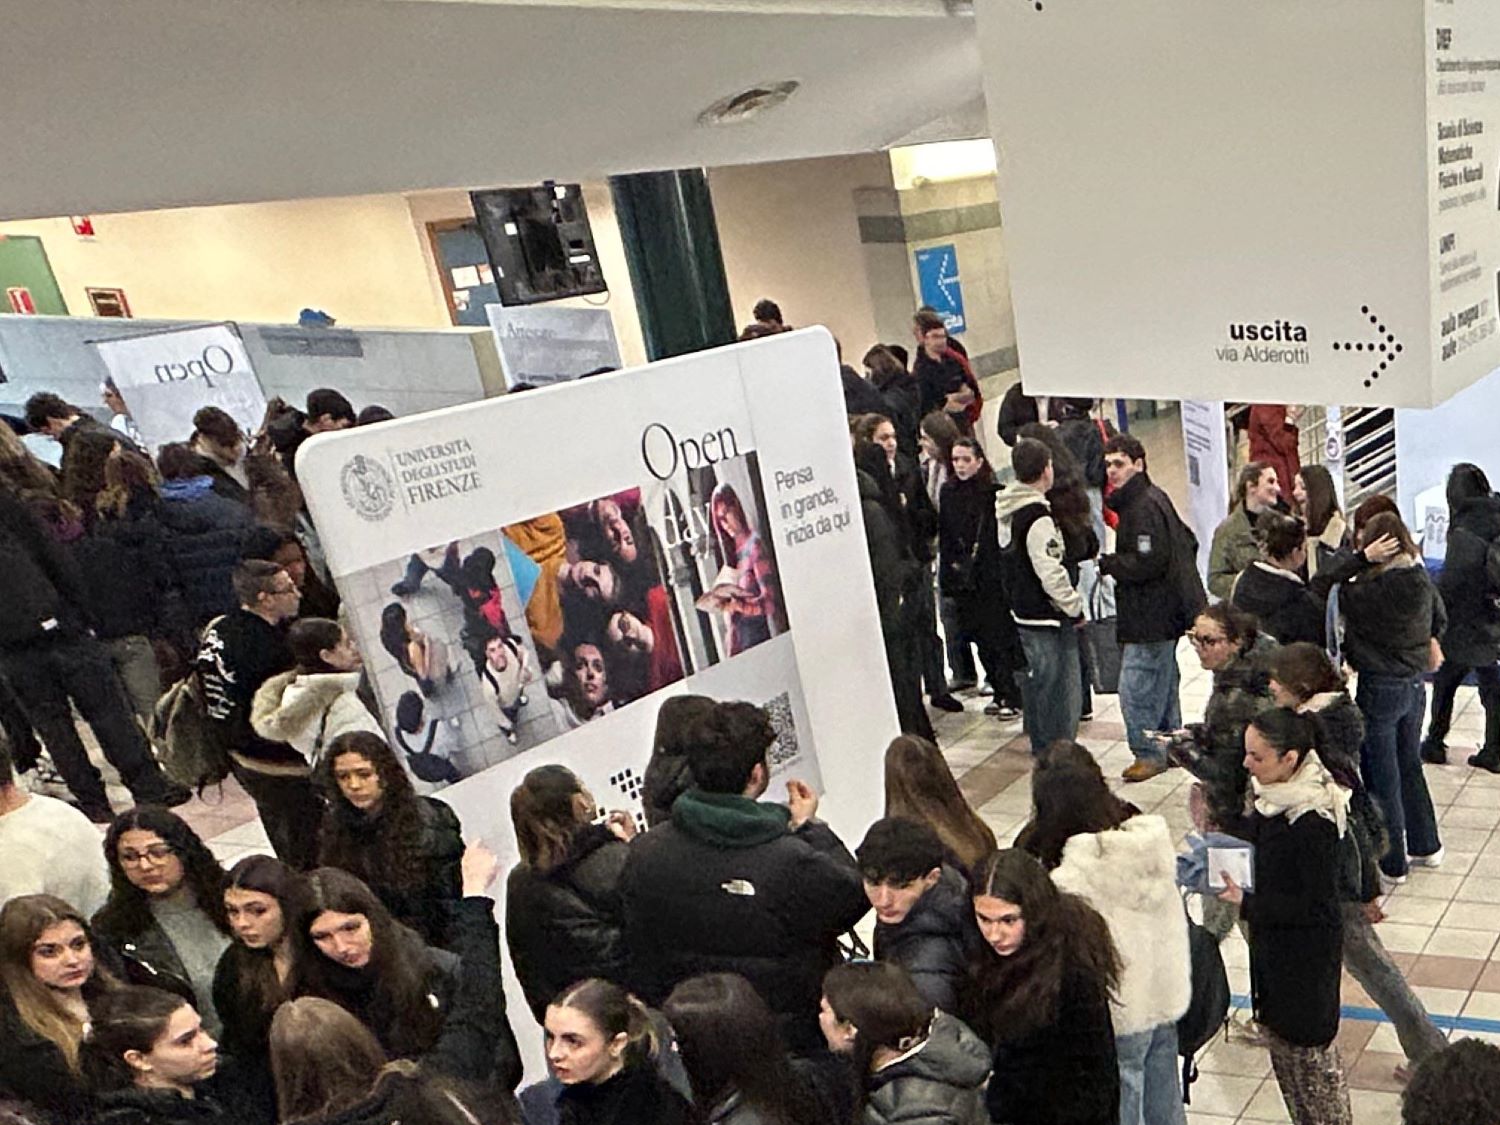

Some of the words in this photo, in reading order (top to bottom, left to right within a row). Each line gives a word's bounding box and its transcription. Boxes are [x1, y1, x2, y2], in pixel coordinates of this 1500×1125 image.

[1230, 319, 1307, 342] uscita
[1216, 347, 1238, 362] via
[1243, 345, 1310, 364] Alderotti
[401, 463, 441, 483] DEGLI
[440, 454, 477, 476] STUDI
[641, 422, 741, 490] Open
[406, 472, 483, 505] FIRENZE
[774, 465, 814, 491] Pensa
[780, 497, 793, 520] in
[794, 487, 840, 520] grande,
[663, 486, 711, 560] day
[784, 519, 815, 547] inizia
[816, 512, 832, 537] da
[833, 509, 852, 536] qui
